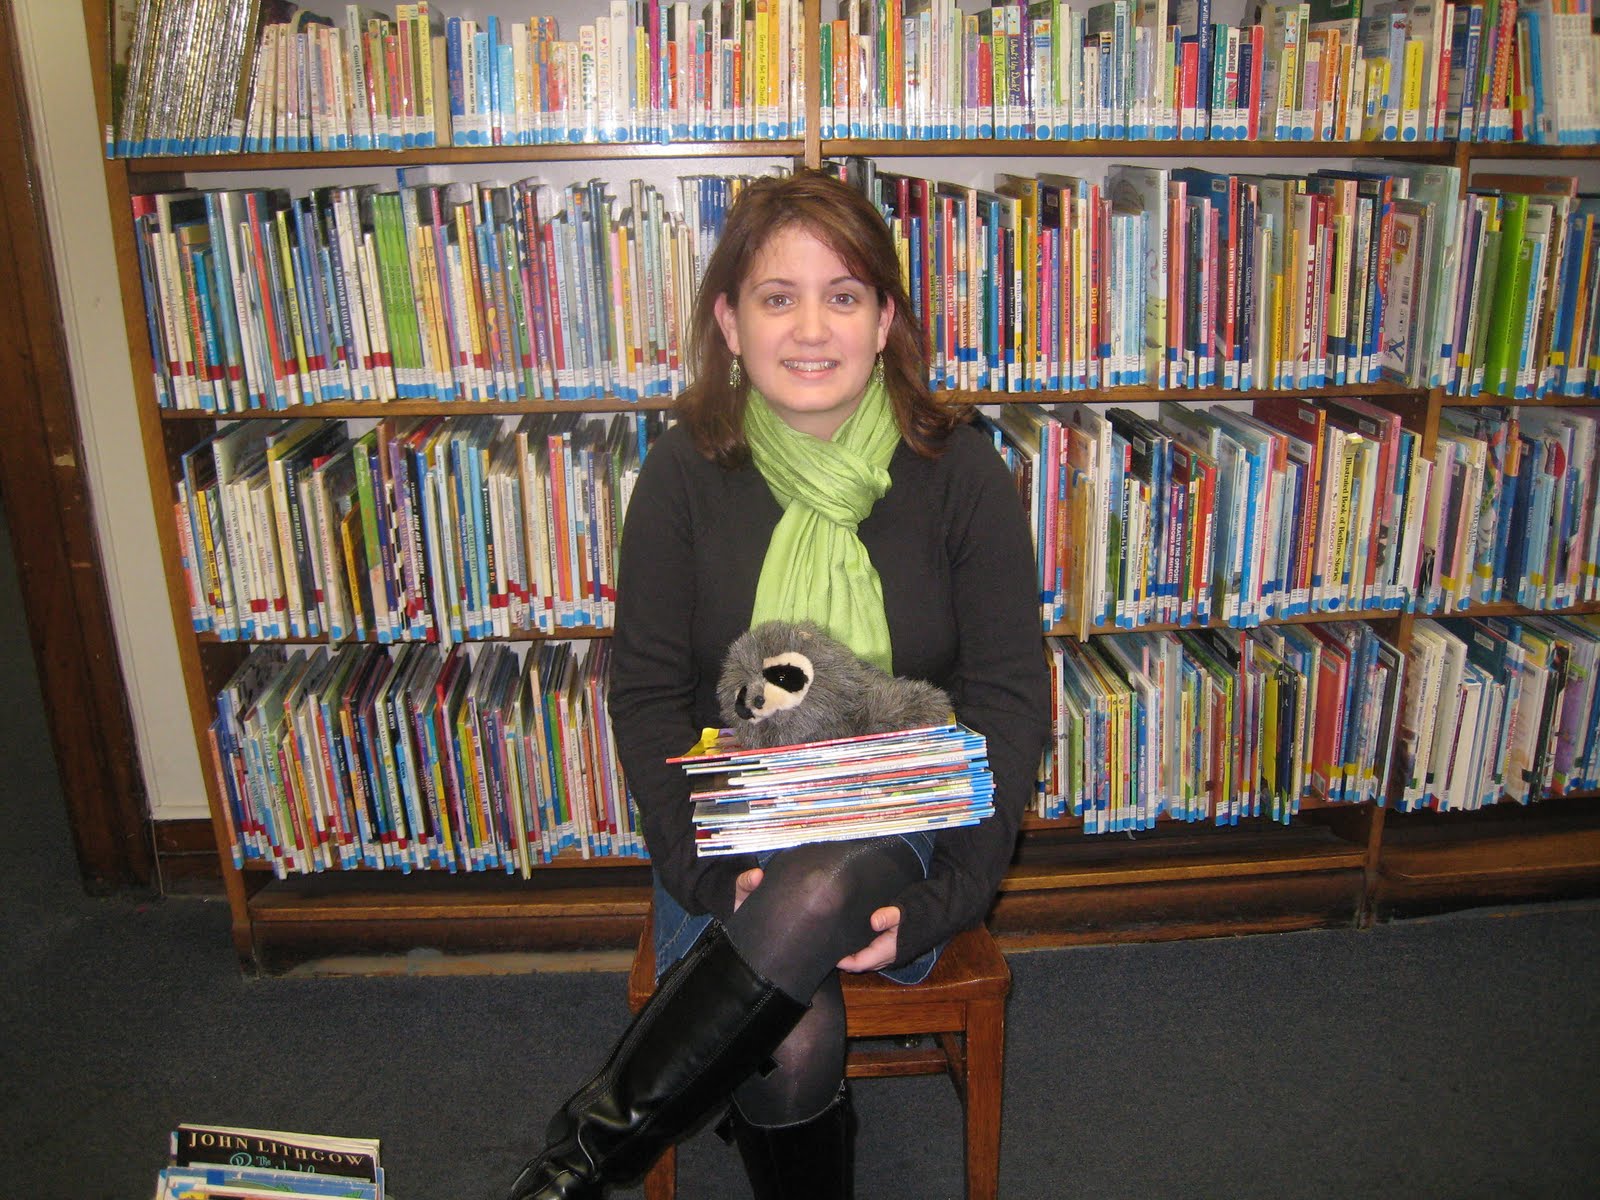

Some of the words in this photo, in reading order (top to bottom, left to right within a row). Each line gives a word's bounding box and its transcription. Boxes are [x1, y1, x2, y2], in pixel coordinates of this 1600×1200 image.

[353, 45, 361, 68] Count
[1009, 71, 1019, 90] Duck?
[1383, 224, 1387, 232] My
[291, 303, 297, 311] on
[335, 266, 346, 305] BARNYARD
[341, 308, 350, 338] LULLABY
[292, 313, 300, 336] Parade
[1342, 456, 1351, 493] Illustrated
[1340, 495, 1348, 515] Book
[1336, 526, 1344, 555] Bedtime
[486, 544, 494, 570] MARKET
[1333, 558, 1341, 581] Stories
[189, 1132, 248, 1149] JOHN
[258, 1141, 364, 1166] LITHGOW
